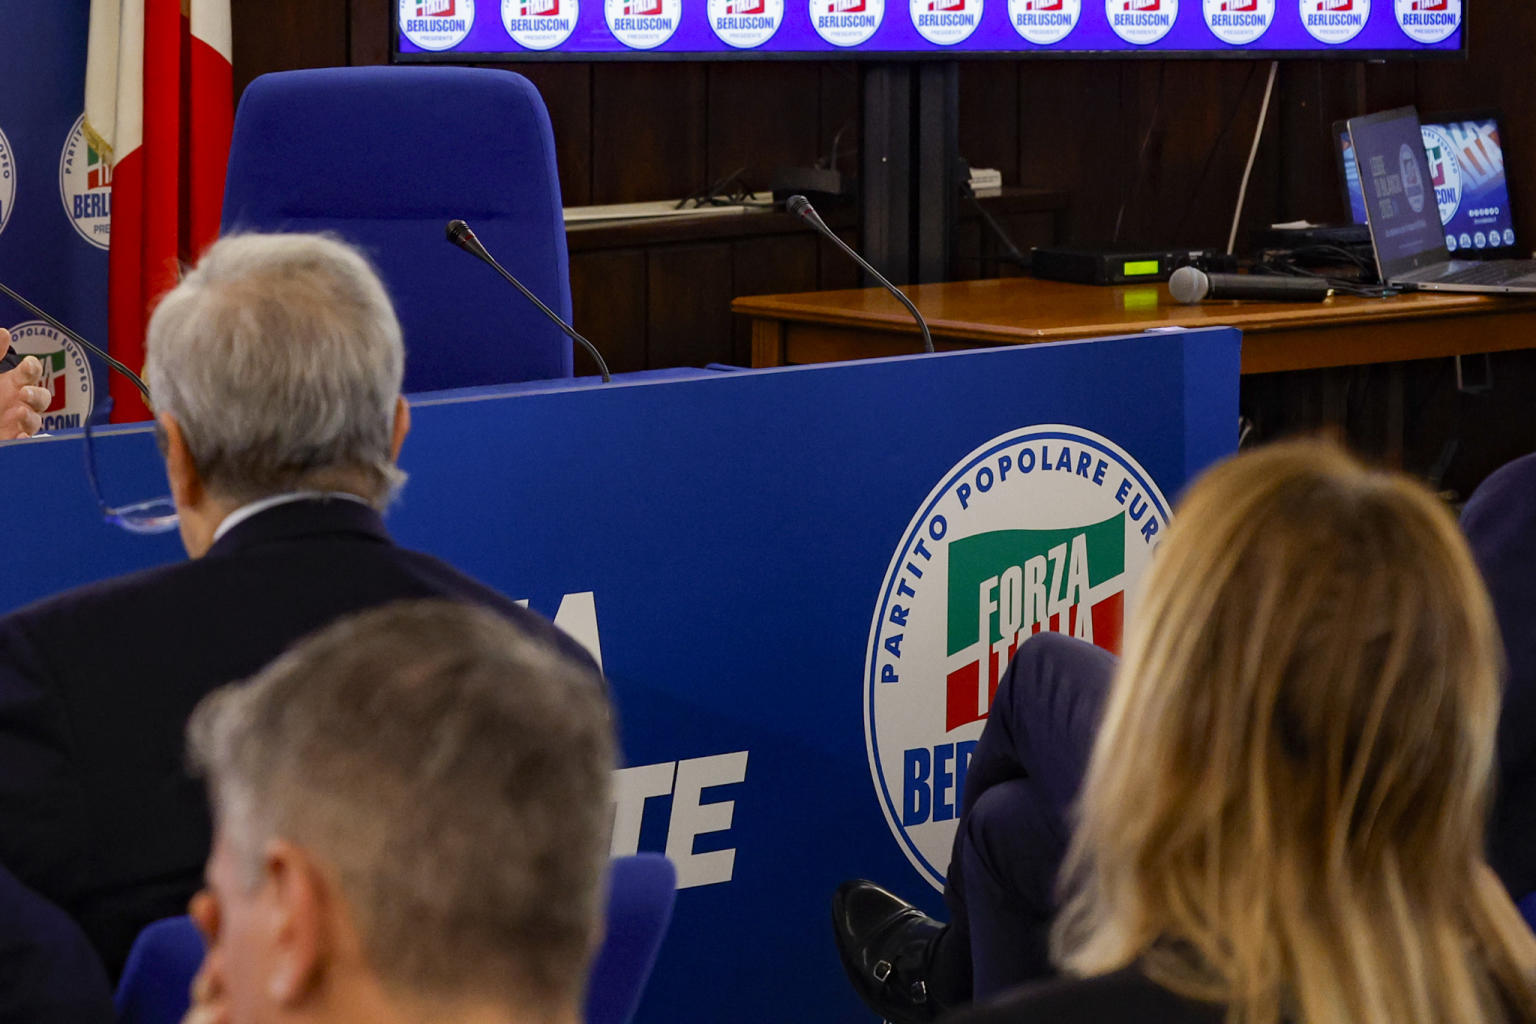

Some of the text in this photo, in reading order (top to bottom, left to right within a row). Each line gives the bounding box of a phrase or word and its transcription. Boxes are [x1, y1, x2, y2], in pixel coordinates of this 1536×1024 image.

[406, 18, 465, 32] BERLUSCONI
[511, 18, 569, 31] BERLUSCONI
[614, 18, 672, 31] BERLUSCONI
[717, 16, 774, 30] BERLUSCONI
[819, 15, 875, 28] BERLUSCONI
[919, 13, 974, 26] BERLUSCONI
[1017, 14, 1072, 26] BERLUSCONI
[1114, 14, 1169, 26] BERLUSCONI
[1212, 14, 1266, 26] BERLUSCONI
[1308, 14, 1362, 26] BERLUSCONI
[1403, 13, 1456, 26] BERLUSCONI
[65, 130, 83, 174] PARTIT
[11, 328, 59, 342] OPOLARE
[881, 514, 948, 684] PARTITO
[956, 446, 1109, 510] POPOLARE
[978, 533, 1090, 642] FORZA
